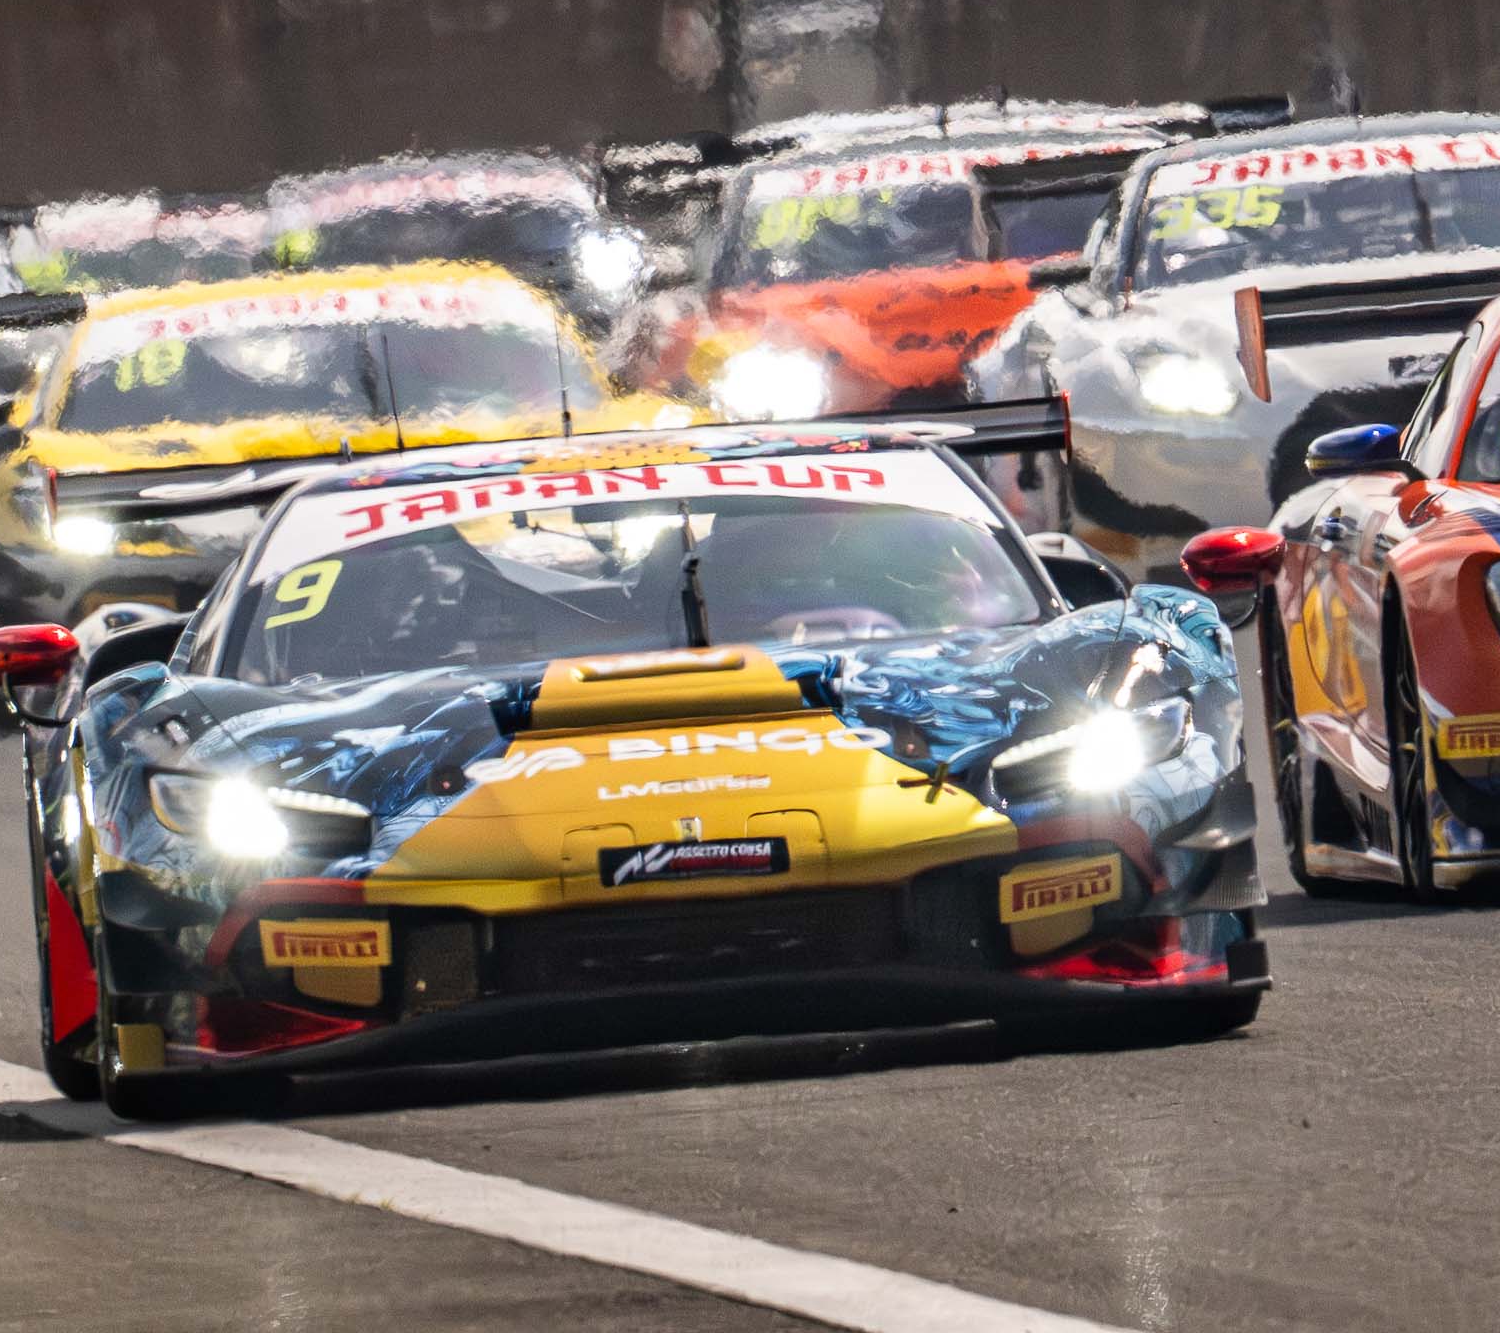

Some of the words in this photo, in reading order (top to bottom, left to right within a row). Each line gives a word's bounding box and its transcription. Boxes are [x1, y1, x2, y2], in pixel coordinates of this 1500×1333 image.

[1191, 144, 1416, 186] JAPAN
[343, 465, 669, 539] JAPAN
[698, 463, 886, 493] CUP
[265, 559, 343, 630] 9
[608, 727, 892, 762] BINGO
[1011, 864, 1112, 913] PIRELLI
[271, 929, 380, 961] PIRELLI
